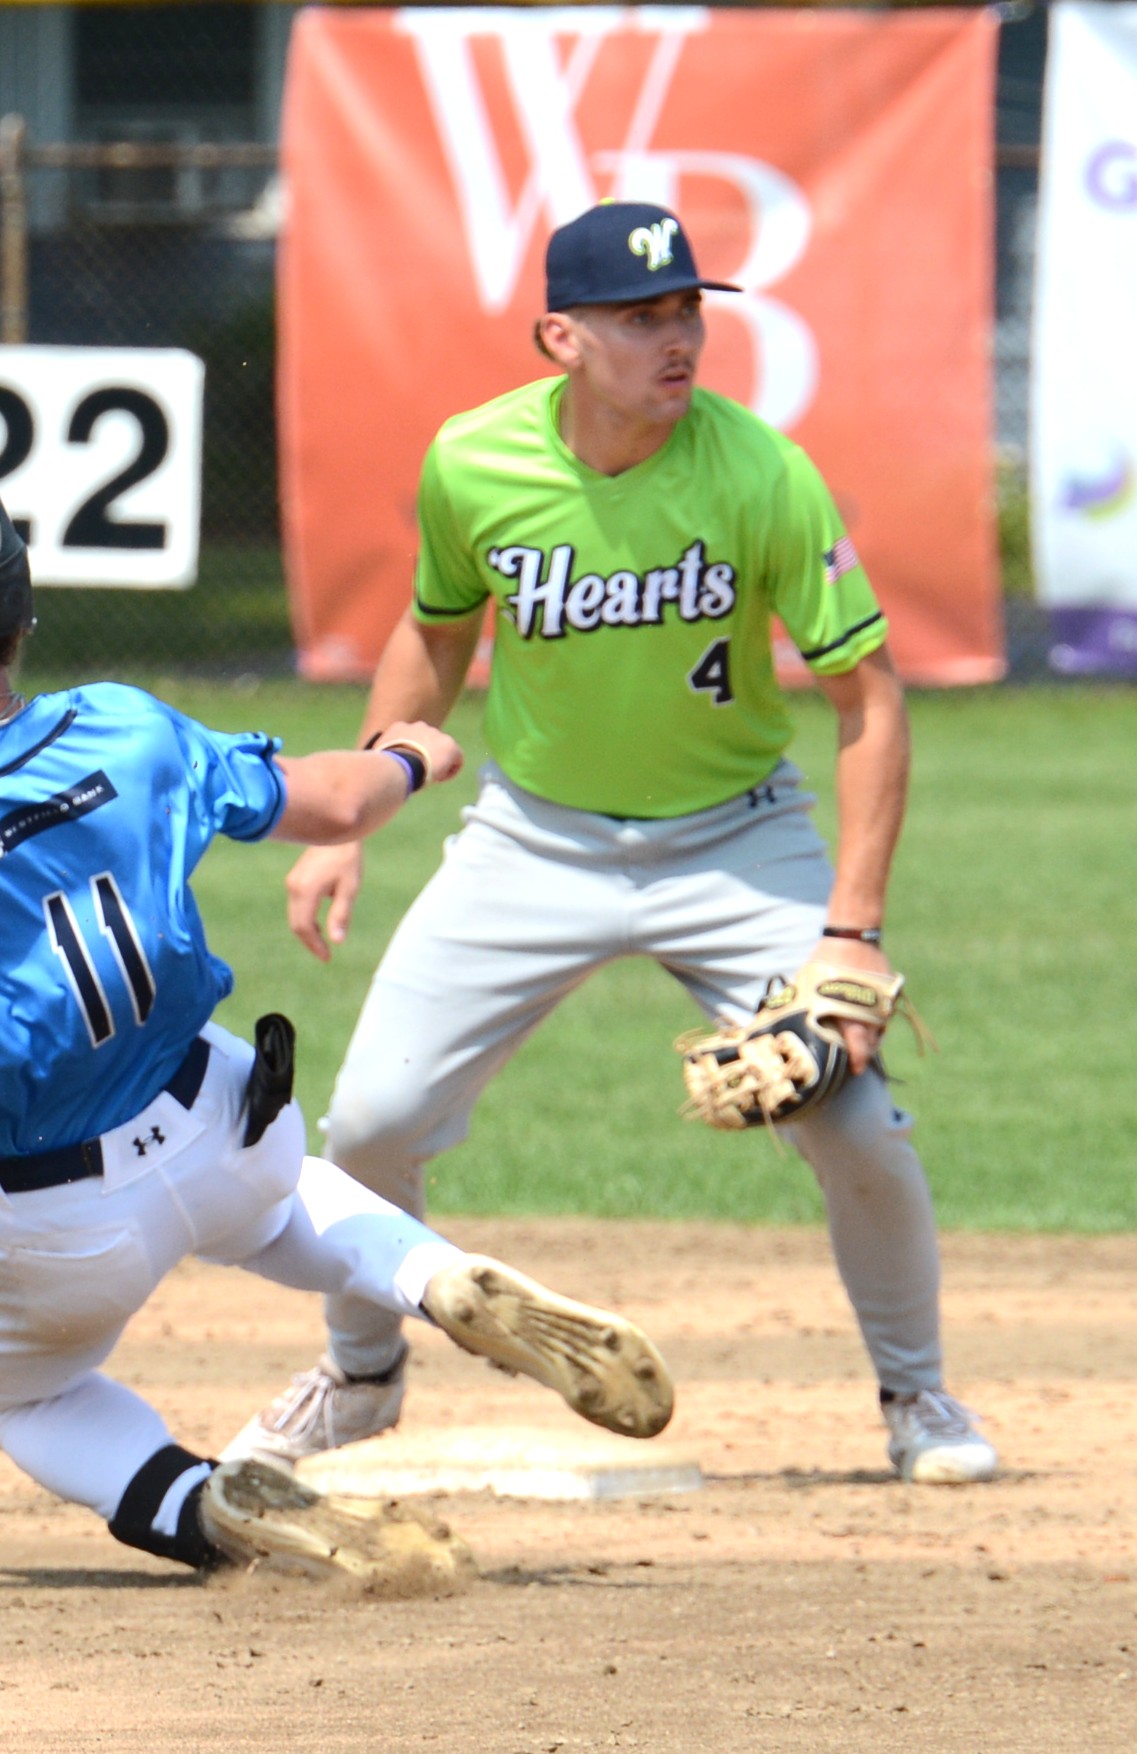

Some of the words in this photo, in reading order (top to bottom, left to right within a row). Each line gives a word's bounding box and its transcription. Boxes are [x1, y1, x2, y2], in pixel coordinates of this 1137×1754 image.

[628, 217, 679, 271] W
[488, 539, 736, 640] Hearts
[687, 634, 735, 707] 4
[42, 870, 157, 1049] 11
